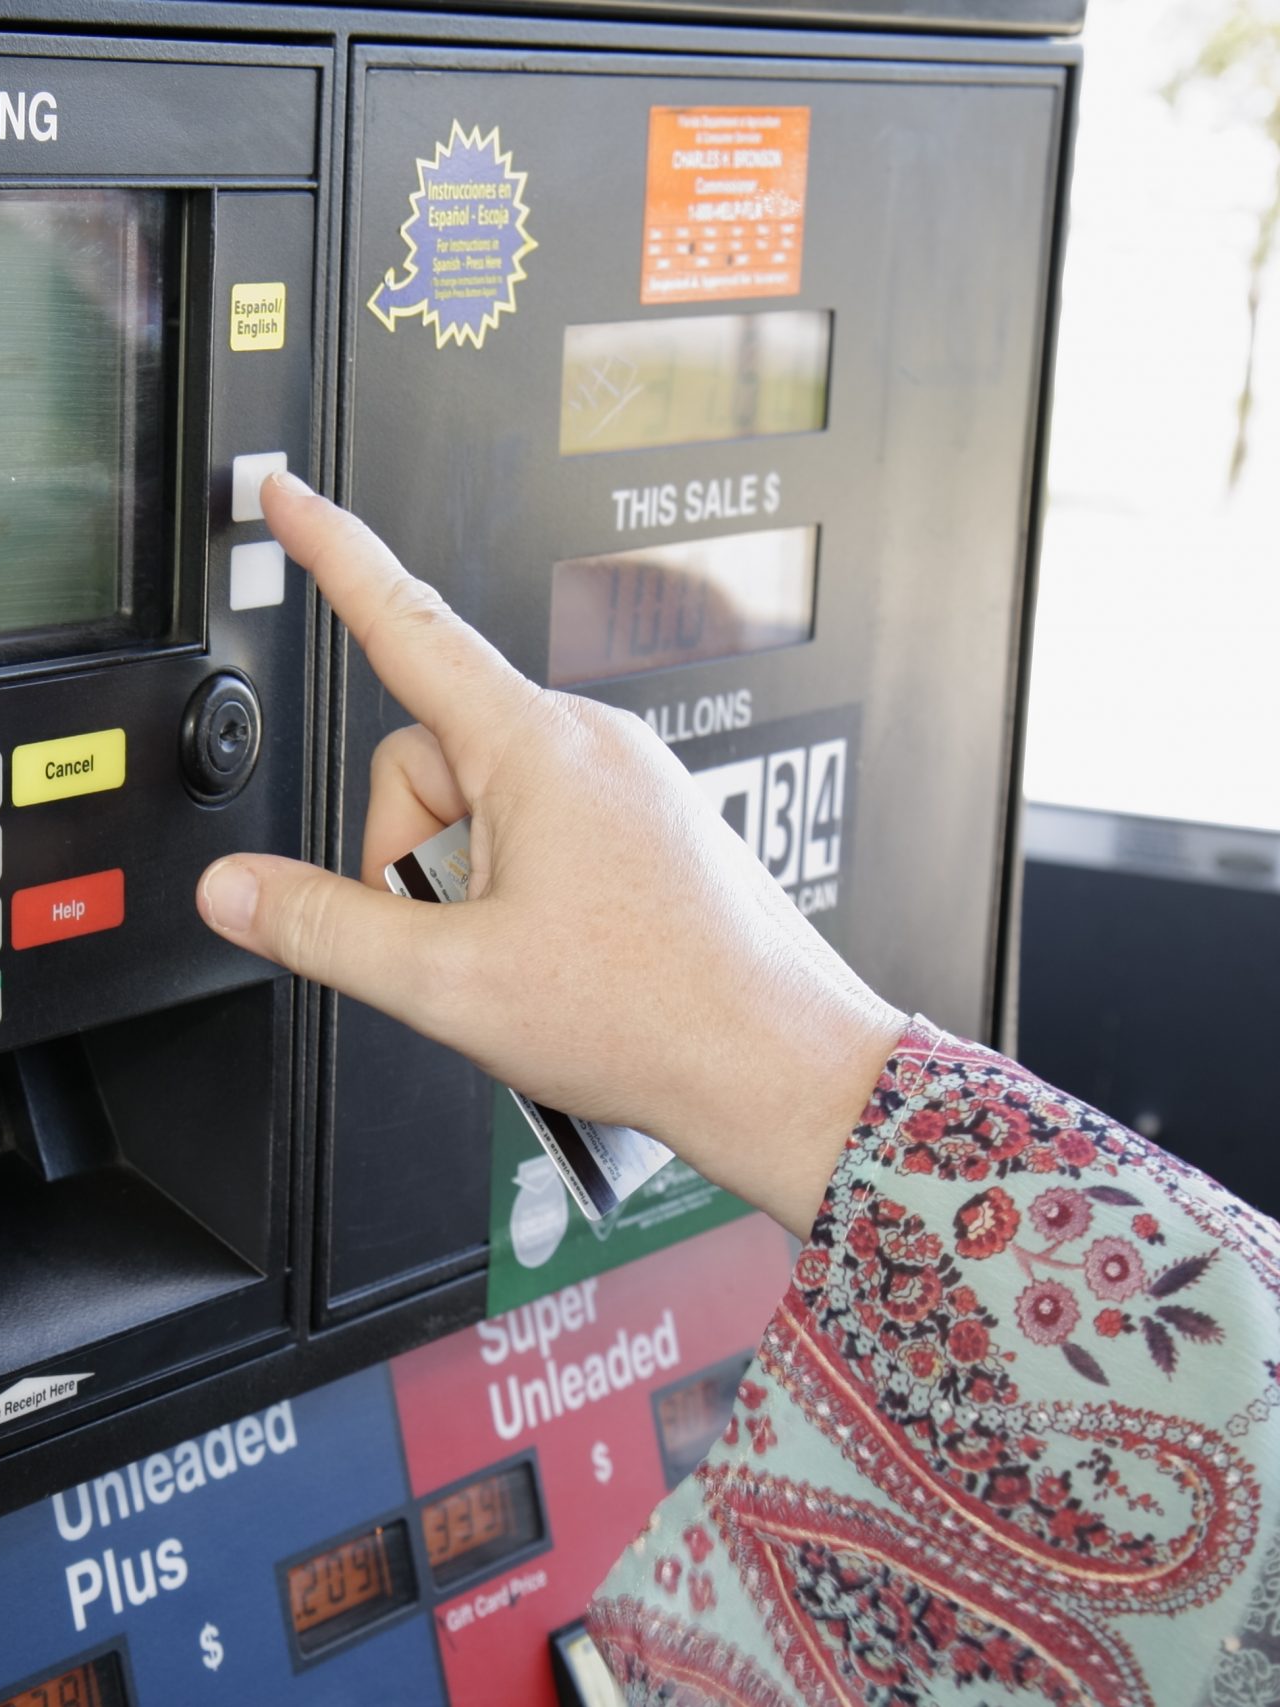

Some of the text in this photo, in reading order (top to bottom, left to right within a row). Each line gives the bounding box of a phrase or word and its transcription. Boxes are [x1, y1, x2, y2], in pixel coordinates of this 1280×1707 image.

[428, 178, 512, 200] Instrucciones en
[429, 205, 469, 232] Español
[478, 204, 509, 230] Escoja
[234, 298, 282, 318] Español/
[237, 318, 278, 338] English
[612, 484, 677, 532] THIS
[684, 475, 758, 524] SALE
[643, 688, 752, 744] ALLONS
[45, 754, 94, 780] Cancel
[52, 899, 86, 922] Help
[476, 1277, 598, 1365] Super
[4, 1388, 47, 1416] Receipt
[50, 1380, 75, 1399] Here
[488, 1308, 681, 1441] Unleaded
[52, 1400, 298, 1542] Unleaded
[65, 1537, 189, 1632] Plus
[445, 1569, 548, 1632] Gift Card Price
[199, 1621, 224, 1672] $
